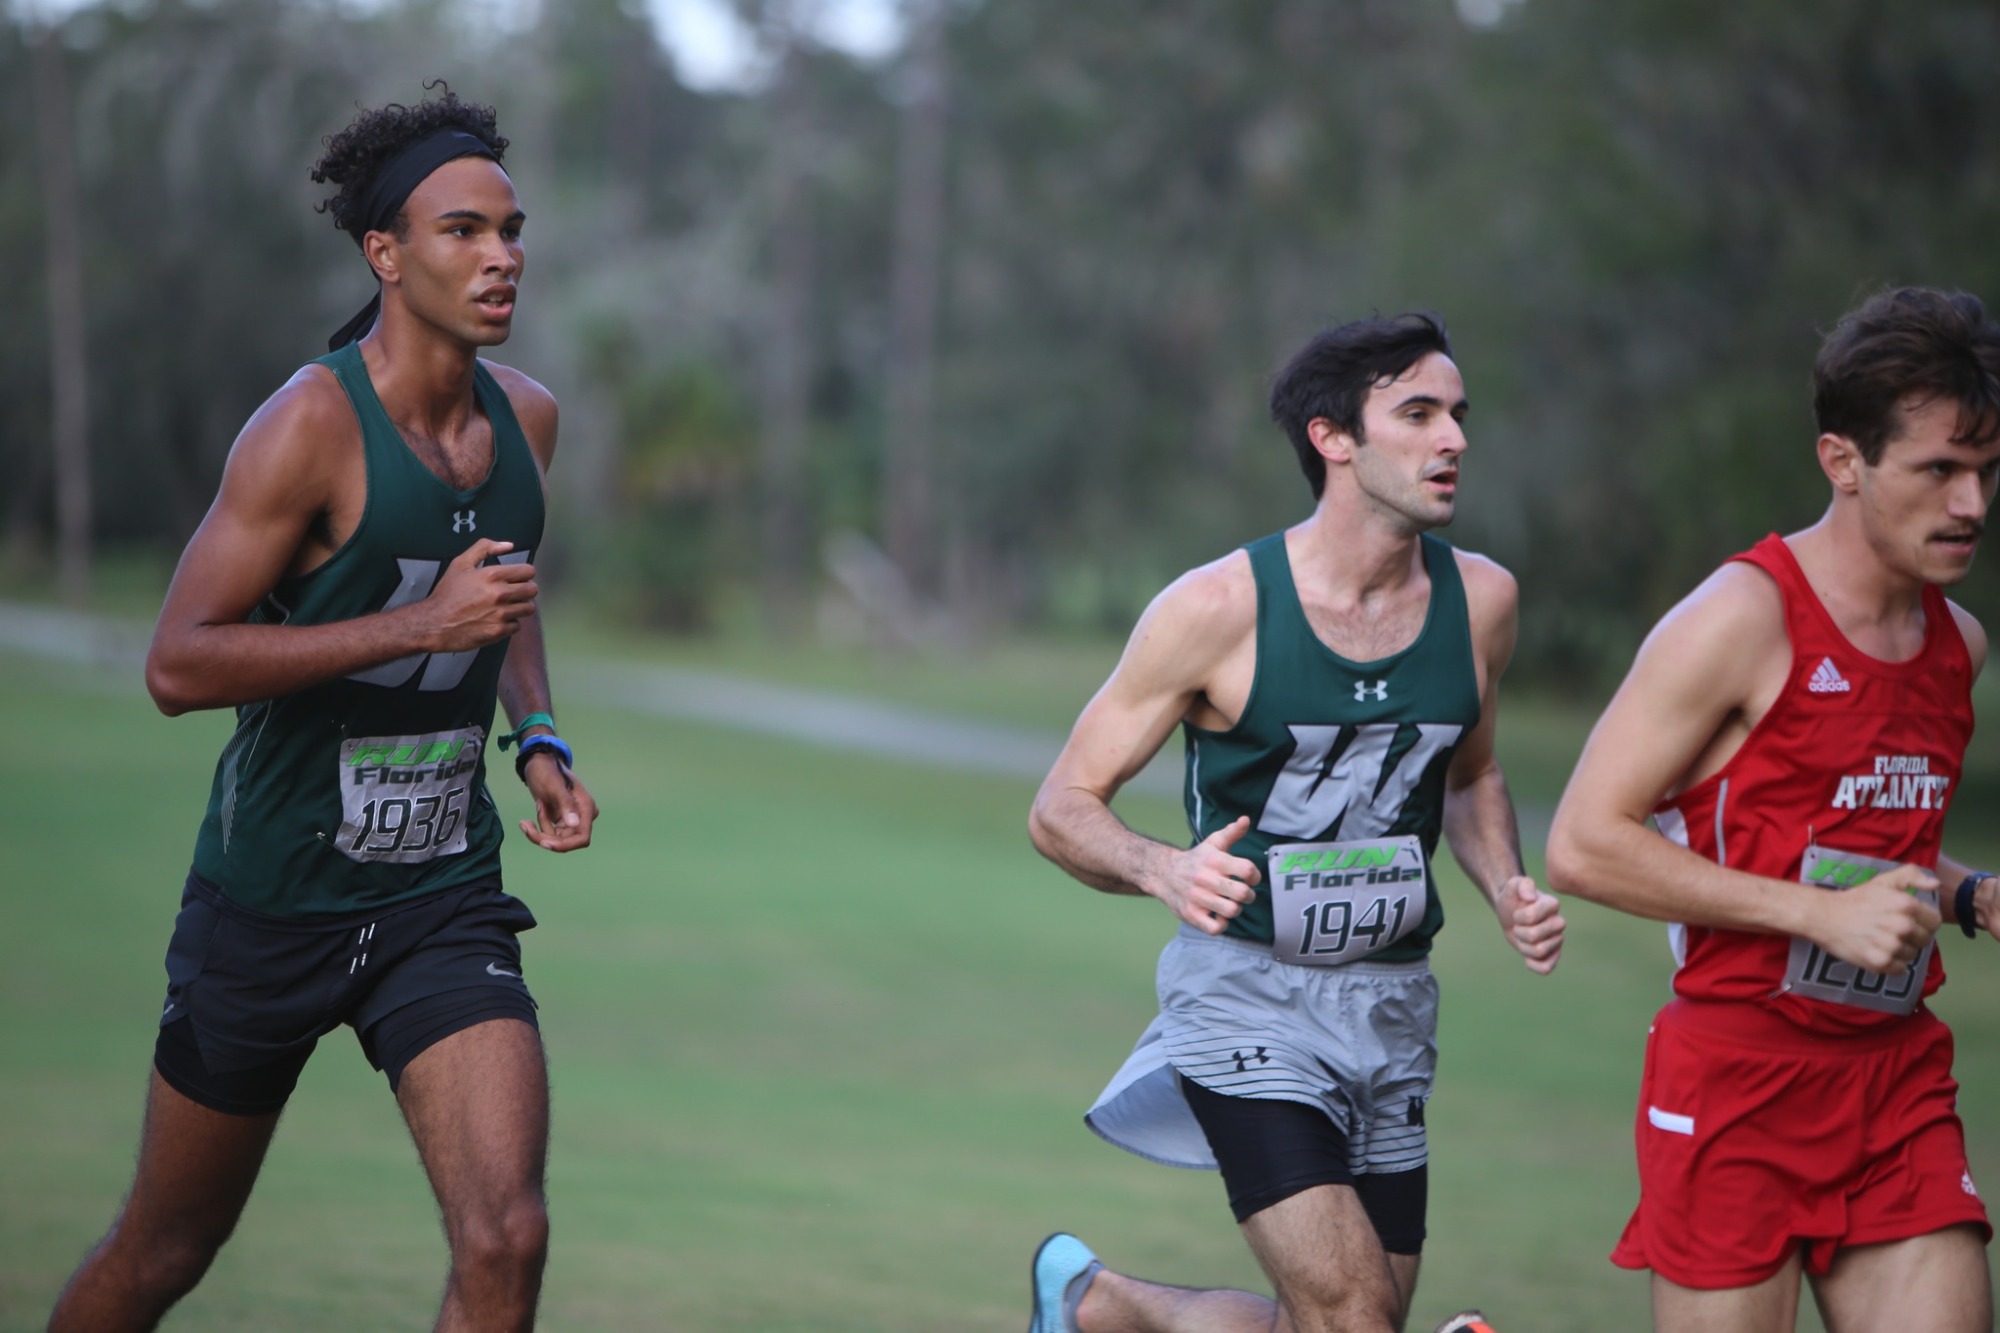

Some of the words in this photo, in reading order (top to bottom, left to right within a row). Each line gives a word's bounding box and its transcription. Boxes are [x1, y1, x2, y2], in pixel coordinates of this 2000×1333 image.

[1808, 680, 1850, 692] adidas
[347, 738, 466, 767] RUN
[1875, 756, 1928, 774] FLORIDA
[354, 760, 476, 785] Florida
[350, 787, 465, 853] 1936
[1277, 846, 1398, 874] RUN
[1285, 867, 1422, 891] Florida
[1298, 895, 1408, 956] 1941
